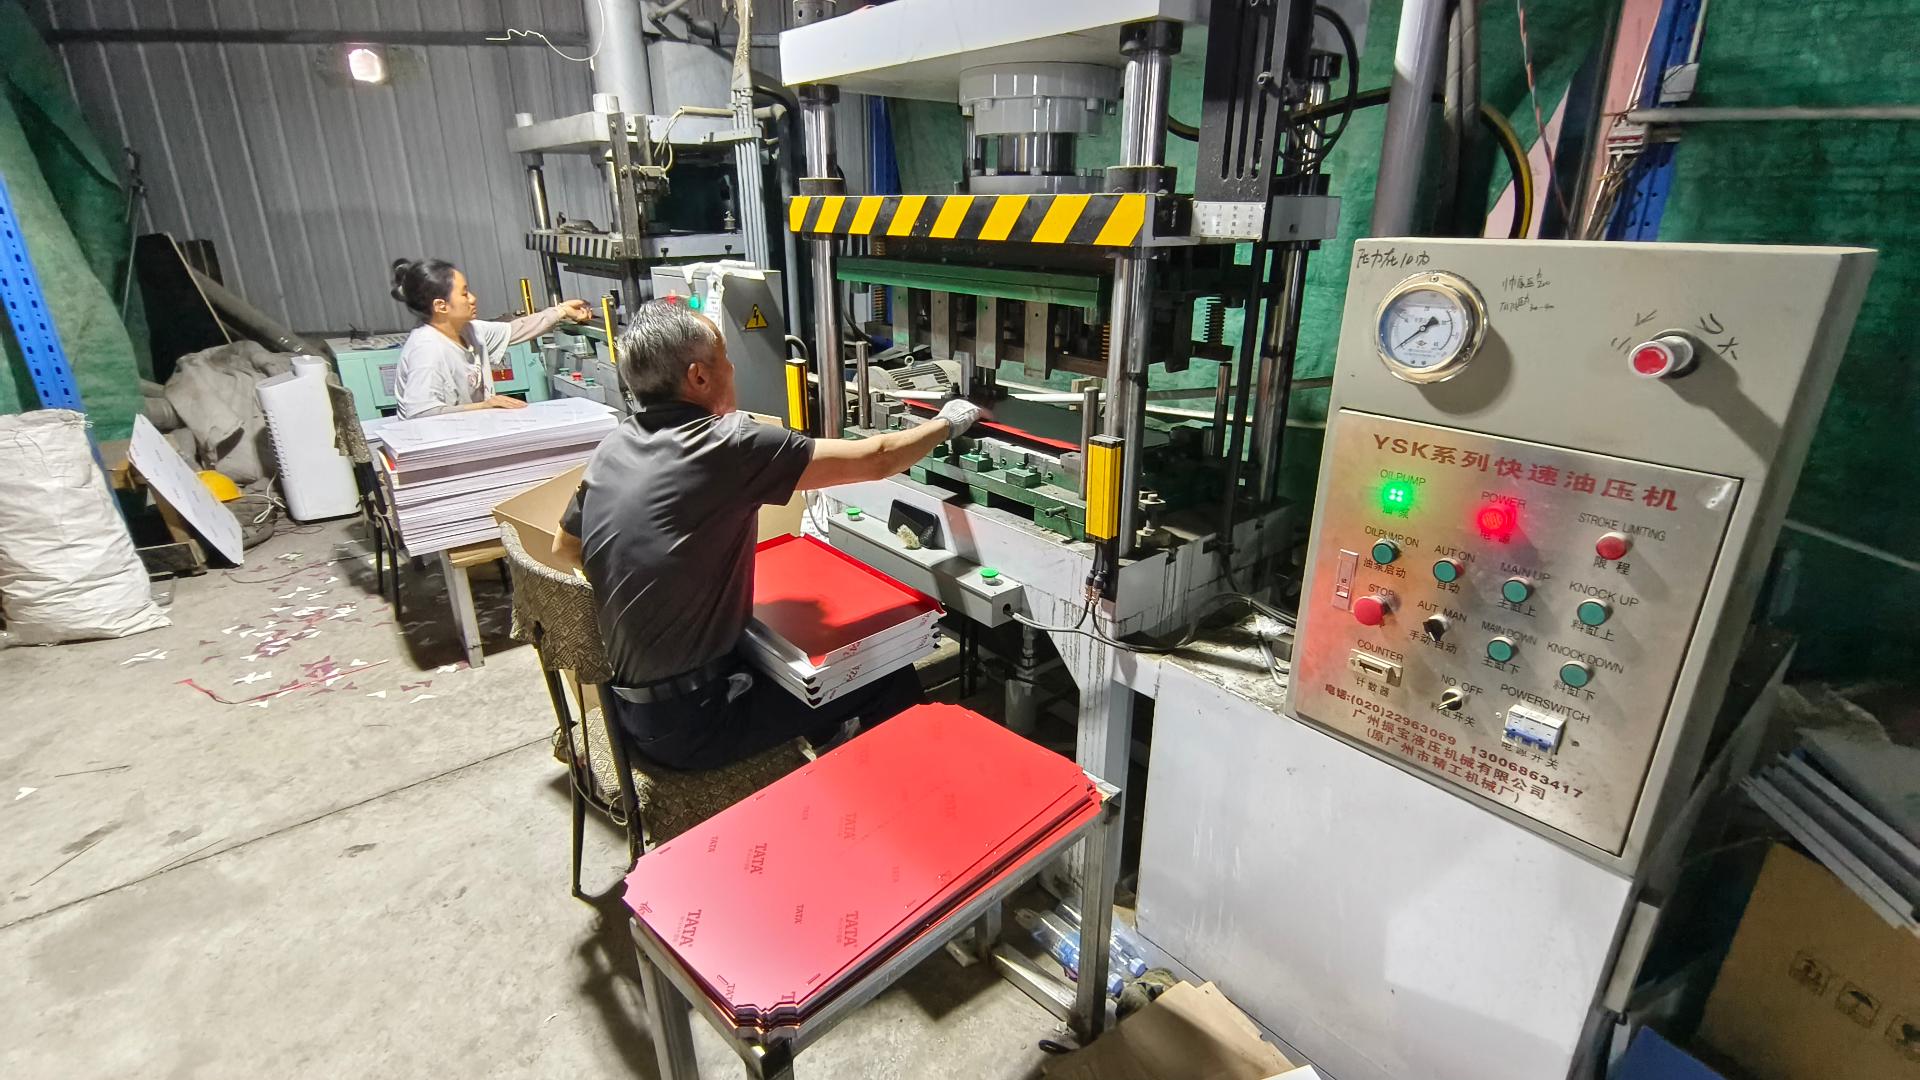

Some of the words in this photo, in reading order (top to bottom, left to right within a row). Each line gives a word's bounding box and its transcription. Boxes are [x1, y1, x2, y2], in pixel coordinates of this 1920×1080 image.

[1373, 434, 1678, 511] YSK系列快速油压机
[1380, 469, 1426, 486] OILPUMP
[1482, 491, 1527, 510] POWER
[1364, 525, 1404, 542] OILPUMP
[1405, 537, 1419, 547] ON
[1578, 512, 1619, 530] STROKE
[1622, 522, 1666, 541] LIMITING
[1434, 545, 1457, 557] AUT
[1458, 551, 1476, 563] ON
[1501, 562, 1532, 578] MAIN
[1534, 571, 1551, 582] UP
[1368, 583, 1395, 598] STOP
[1437, 581, 1460, 594] 自动
[1569, 581, 1616, 602] KNOCK
[1619, 595, 1640, 607] UP
[1417, 600, 1439, 613] AUT
[1443, 608, 1467, 622] MAN
[1481, 620, 1505, 635] MAIN
[1506, 628, 1537, 646] DOWN
[1357, 639, 1404, 662] COUNTER
[1547, 641, 1586, 662] KNOCK
[1587, 654, 1624, 674] DOWN
[1356, 677, 1391, 697] 计数器
[1441, 673, 1457, 686] NO
[1461, 682, 1483, 696] OFF
[1501, 684, 1591, 724] POWERSWITCH
[1471, 746, 1584, 798] 13006863417
[750, 842, 768, 875] TATA
[794, 904, 805, 924] TATA
[679, 909, 703, 948] TATA
[844, 910, 859, 948] TATA
